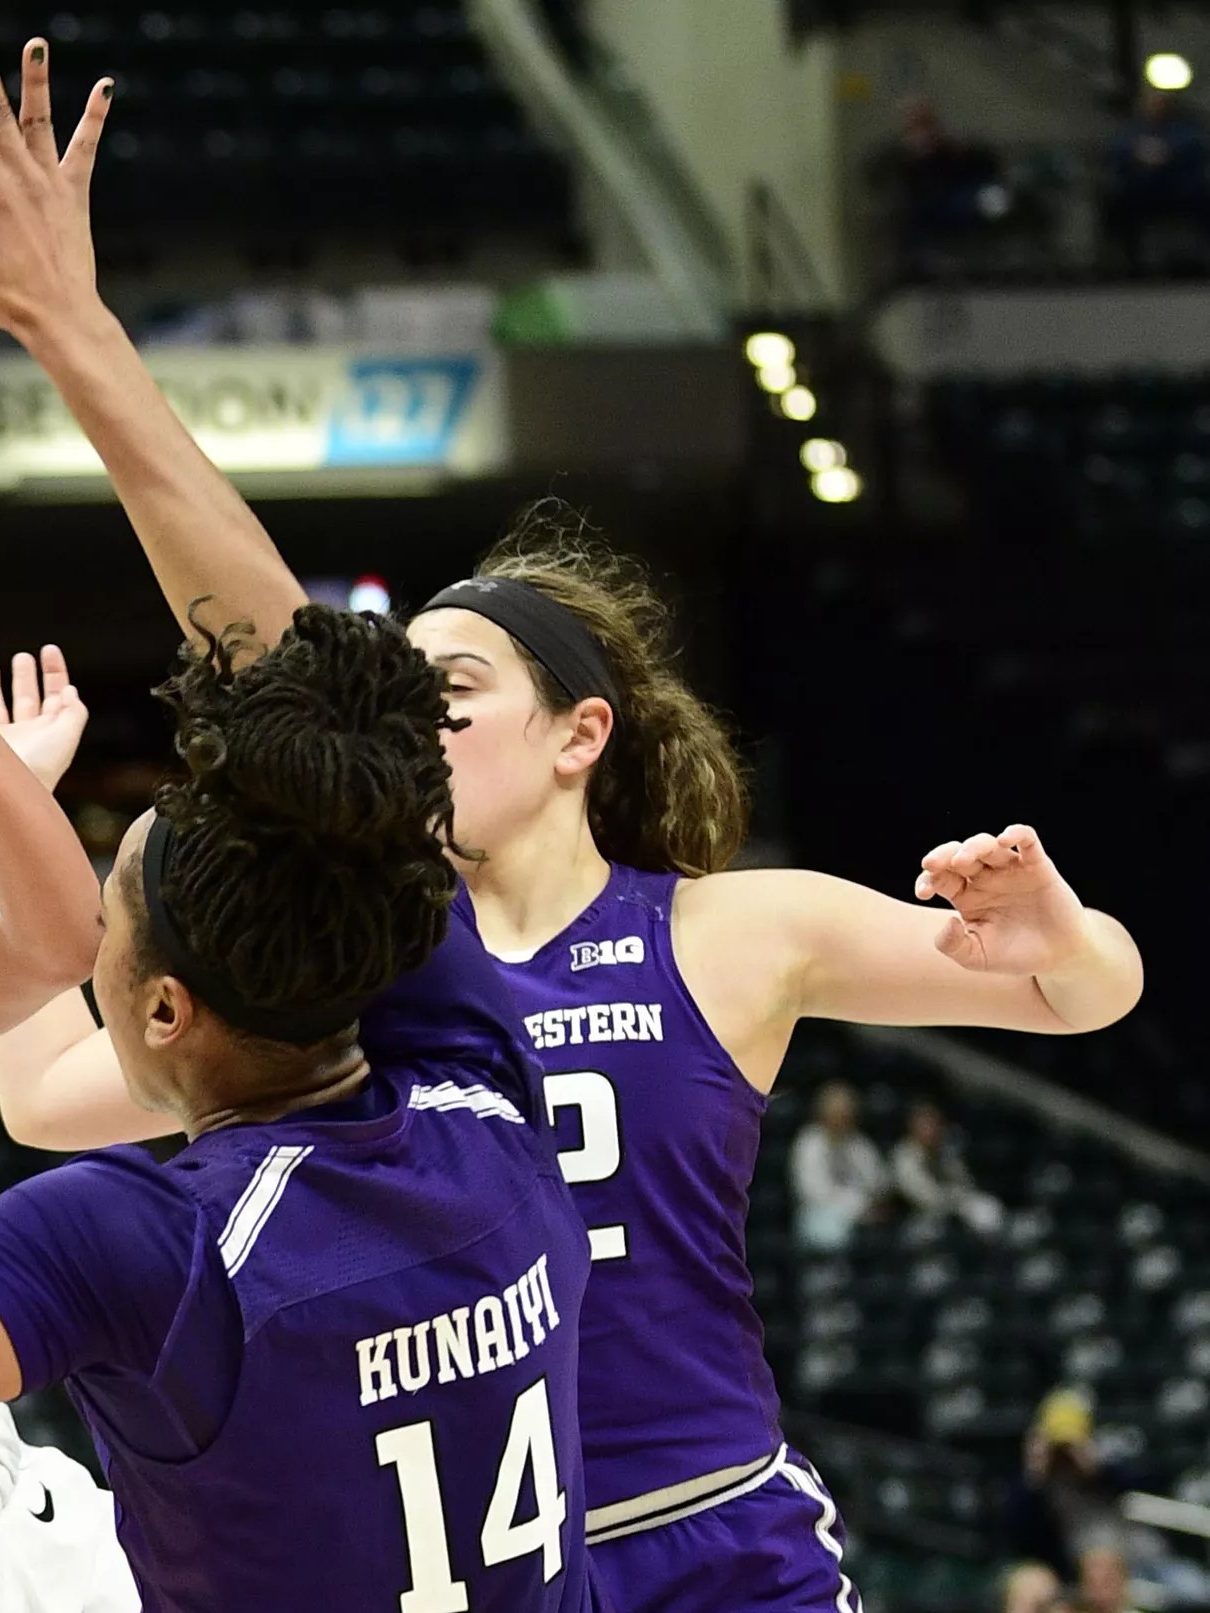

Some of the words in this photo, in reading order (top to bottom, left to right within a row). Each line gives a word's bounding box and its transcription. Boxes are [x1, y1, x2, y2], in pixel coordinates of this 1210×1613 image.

[523, 1003, 663, 1049] ESTERN
[355, 1253, 560, 1406] KUNAIYI
[375, 1374, 566, 1613] 14
